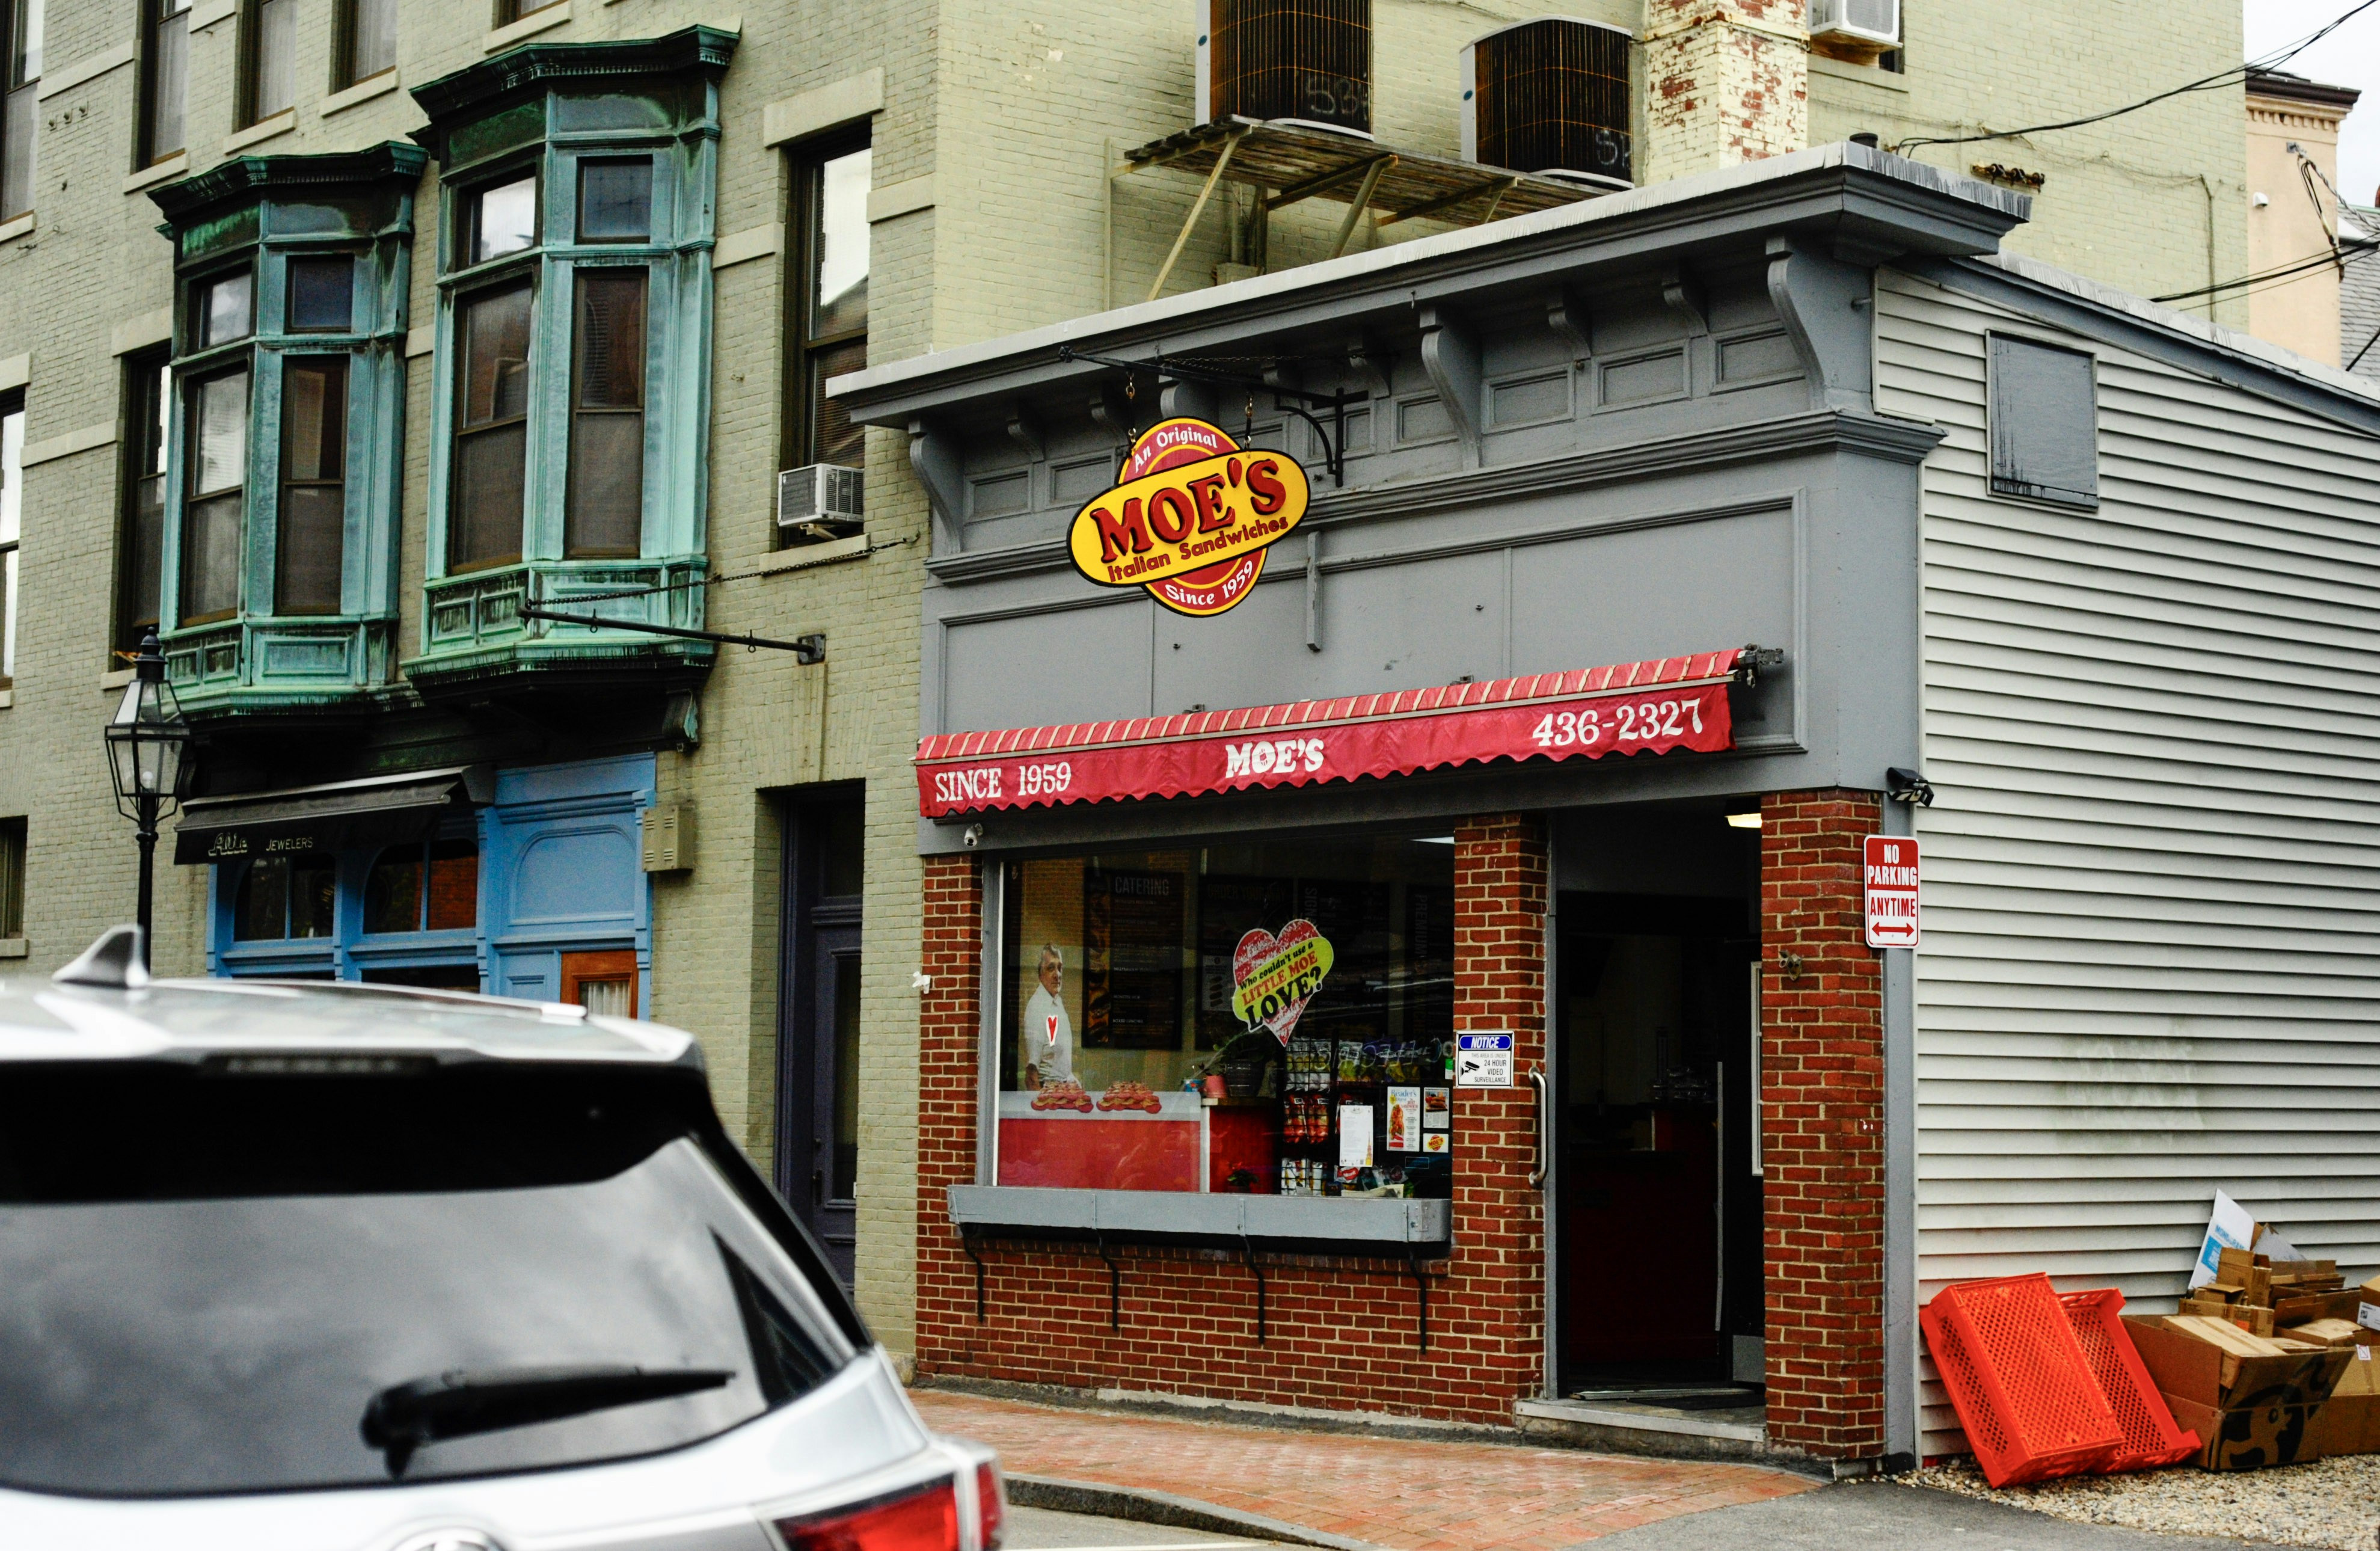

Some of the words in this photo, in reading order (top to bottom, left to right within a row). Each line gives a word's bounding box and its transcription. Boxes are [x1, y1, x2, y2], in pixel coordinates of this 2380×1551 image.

[1134, 444, 1152, 473] An
[1156, 426, 1218, 449] Original
[1089, 457, 1287, 564] MOE'S
[1106, 551, 1171, 583] Italian
[1180, 516, 1289, 561] Sandwiches
[1165, 583, 1215, 605] Since
[1222, 559, 1254, 598] 1959
[1532, 698, 1703, 746] 436-2327
[1225, 738, 1324, 779] MOE'S
[935, 767, 1002, 802] SINCE
[1018, 761, 1072, 797] 1959
[266, 837, 313, 852] JEWELERS
[1883, 844, 1900, 864] NO
[1115, 876, 1170, 896] CATERING
[1867, 865, 1917, 886] PARKING
[1870, 897, 1916, 917] ANYTIME
[1238, 975, 1258, 991] Who
[1259, 953, 1292, 980] couldn't
[1292, 947, 1307, 960] use
[1307, 941, 1314, 949] a
[1241, 969, 1287, 1006] LITTLE
[1287, 950, 1319, 980] MOE
[1245, 965, 1322, 1031] LOVE?
[1470, 1037, 1500, 1049] NOTICE
